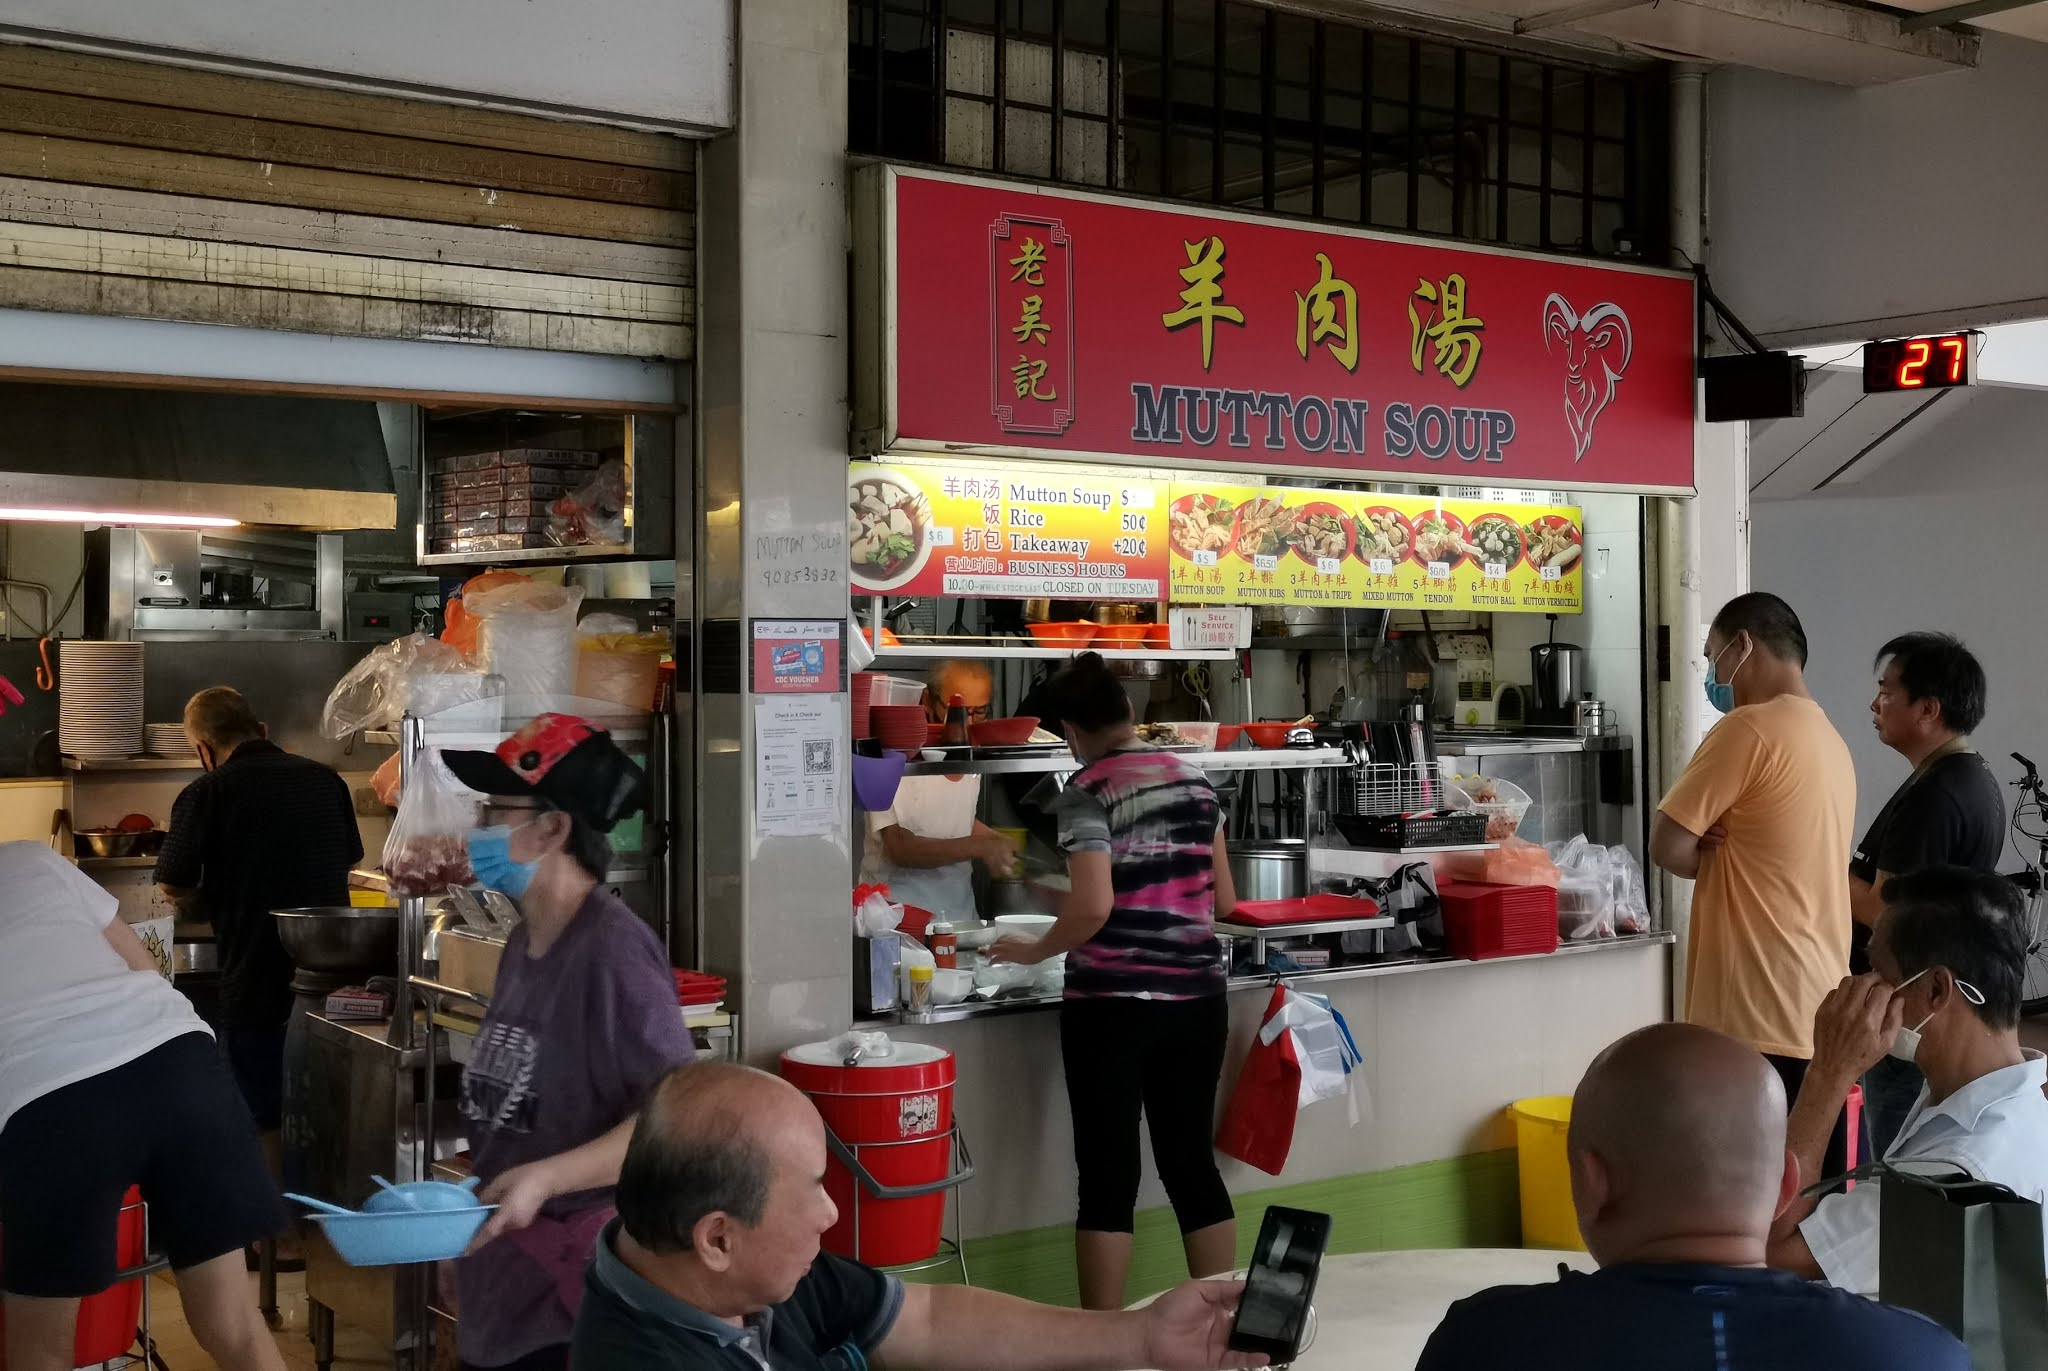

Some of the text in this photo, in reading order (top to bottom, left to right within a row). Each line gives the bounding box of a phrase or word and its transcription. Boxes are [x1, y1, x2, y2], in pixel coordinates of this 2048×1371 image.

[1162, 236, 1486, 388] 羊肉湯
[1899, 339, 1963, 387] 27
[1131, 383, 1516, 463] MUTTON SOUP
[943, 475, 1000, 500] 羊肉汤
[1010, 484, 1067, 503] Mutton
[1073, 487, 1111, 510] Soup
[983, 503, 1146, 532] 饭 Rice 50¢
[964, 527, 1146, 558] 打包 Takeaway +20¢
[1009, 561, 1074, 575] BUSINESS
[1078, 563, 1125, 577] HOURS
[1042, 581, 1084, 593] CLOSED
[1088, 582, 1102, 593] ON
[1107, 582, 1155, 595] TUESDAY
[1174, 585, 1225, 595] MUTTON SOUP
[1237, 587, 1286, 598] MUTTON RIBS
[1294, 589, 1323, 599] MUTTON
[1332, 590, 1352, 600] TRIPE
[1363, 591, 1414, 602] MIXED MUTTON
[1424, 594, 1454, 604] TENDON
[1472, 595, 1516, 605] MUTTON BALL
[1523, 597, 1546, 606] MUTTON
[775, 676, 819, 684] CDC VOUCHER
